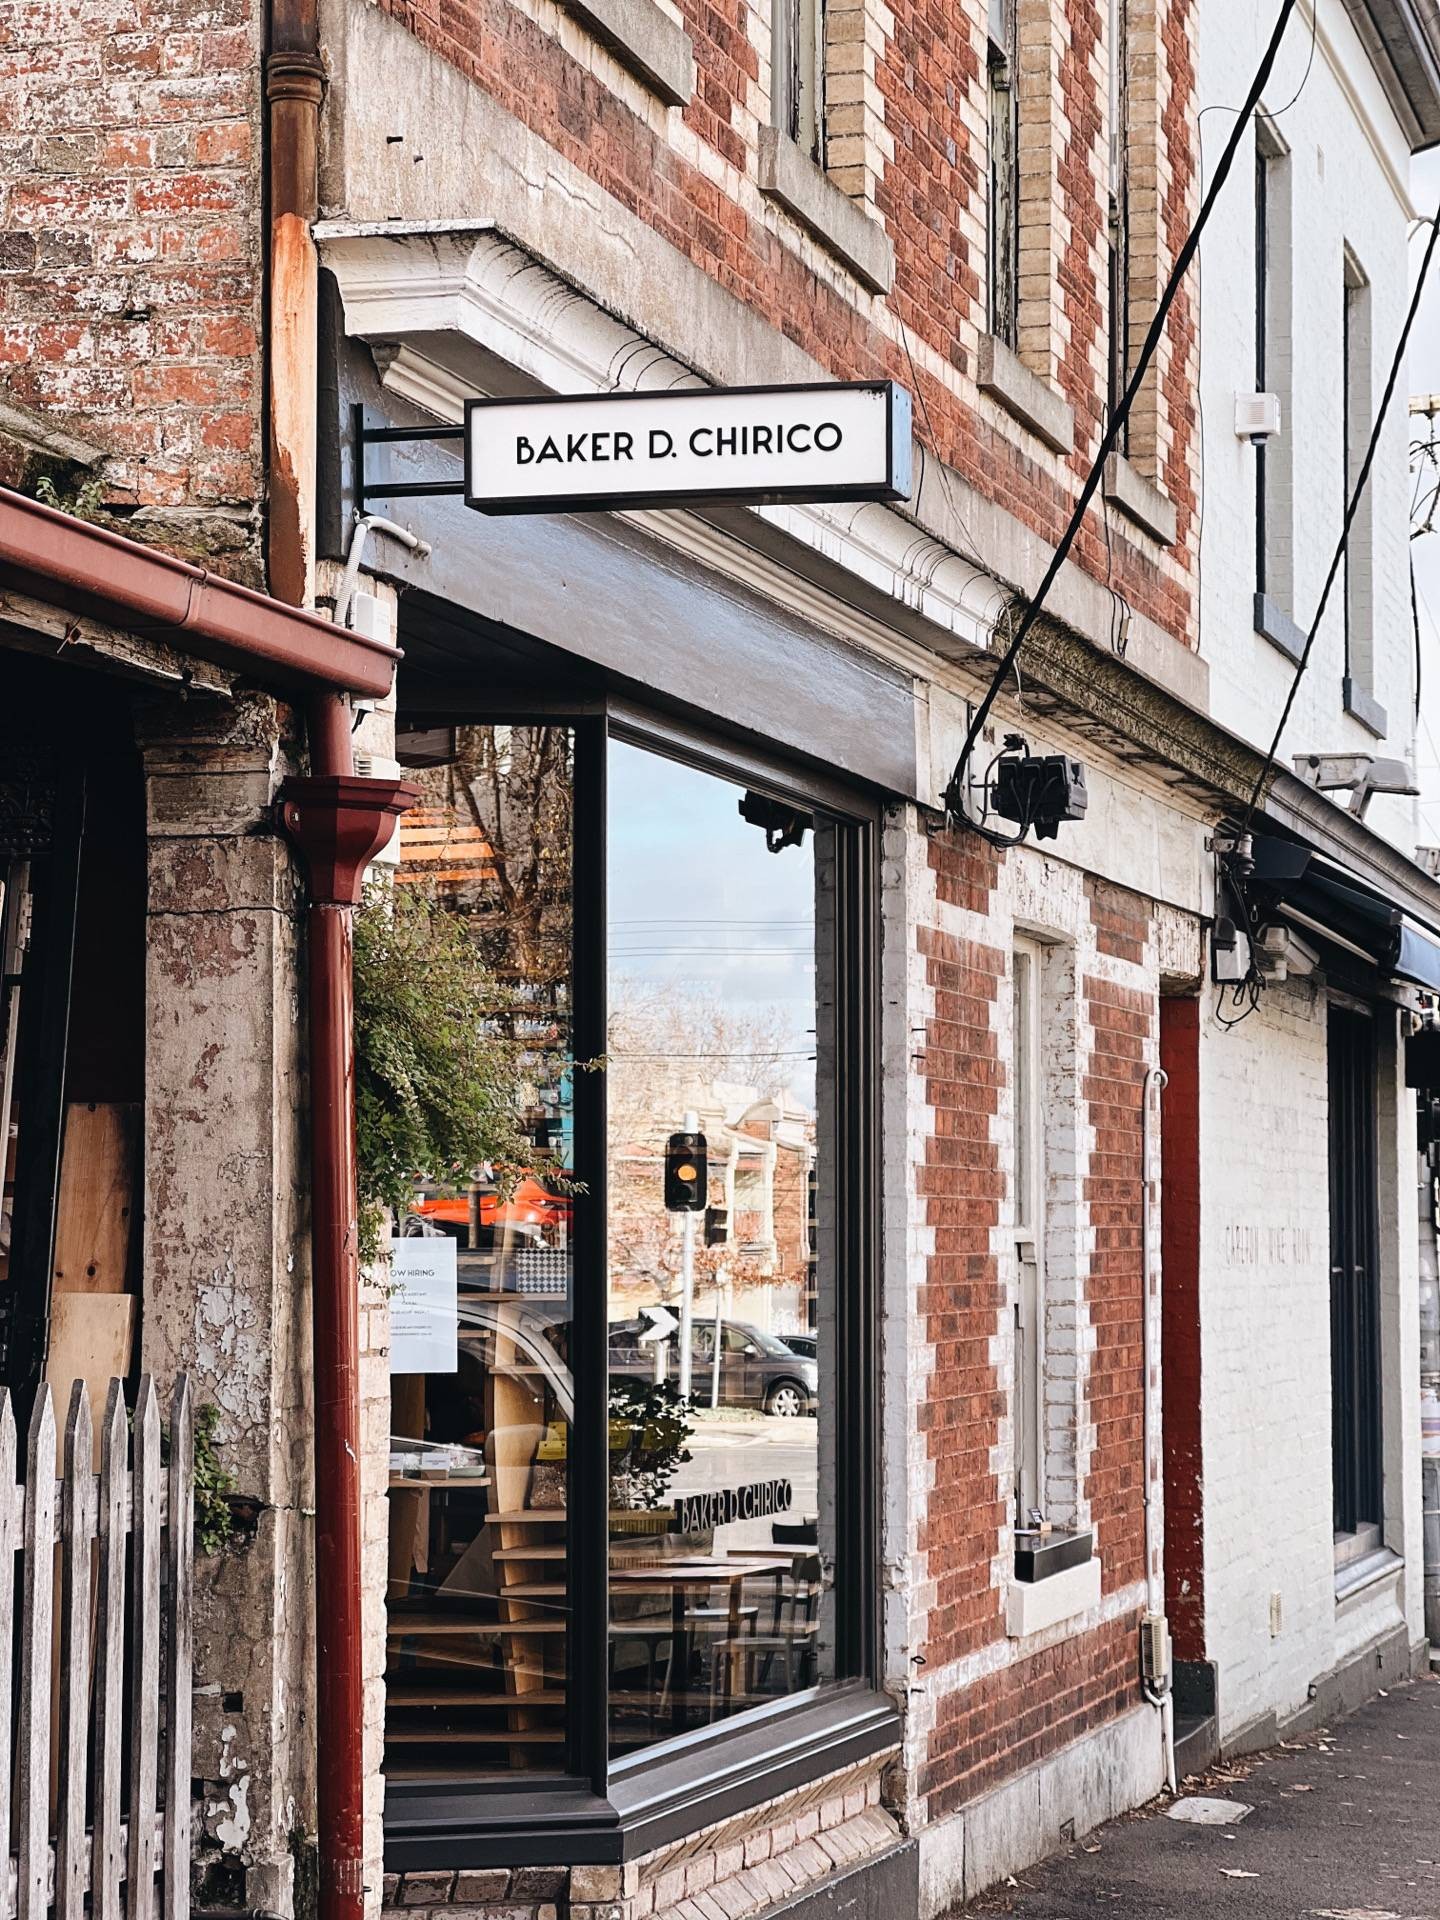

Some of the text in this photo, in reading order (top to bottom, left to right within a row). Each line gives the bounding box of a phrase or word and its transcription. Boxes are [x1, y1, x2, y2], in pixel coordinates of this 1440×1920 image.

[516, 422, 843, 465] BAKER D. CHIRICO
[390, 1269, 435, 1277] OW HIRING
[679, 1490, 726, 1534] BAKER
[741, 1479, 792, 1520] CHIRICO
